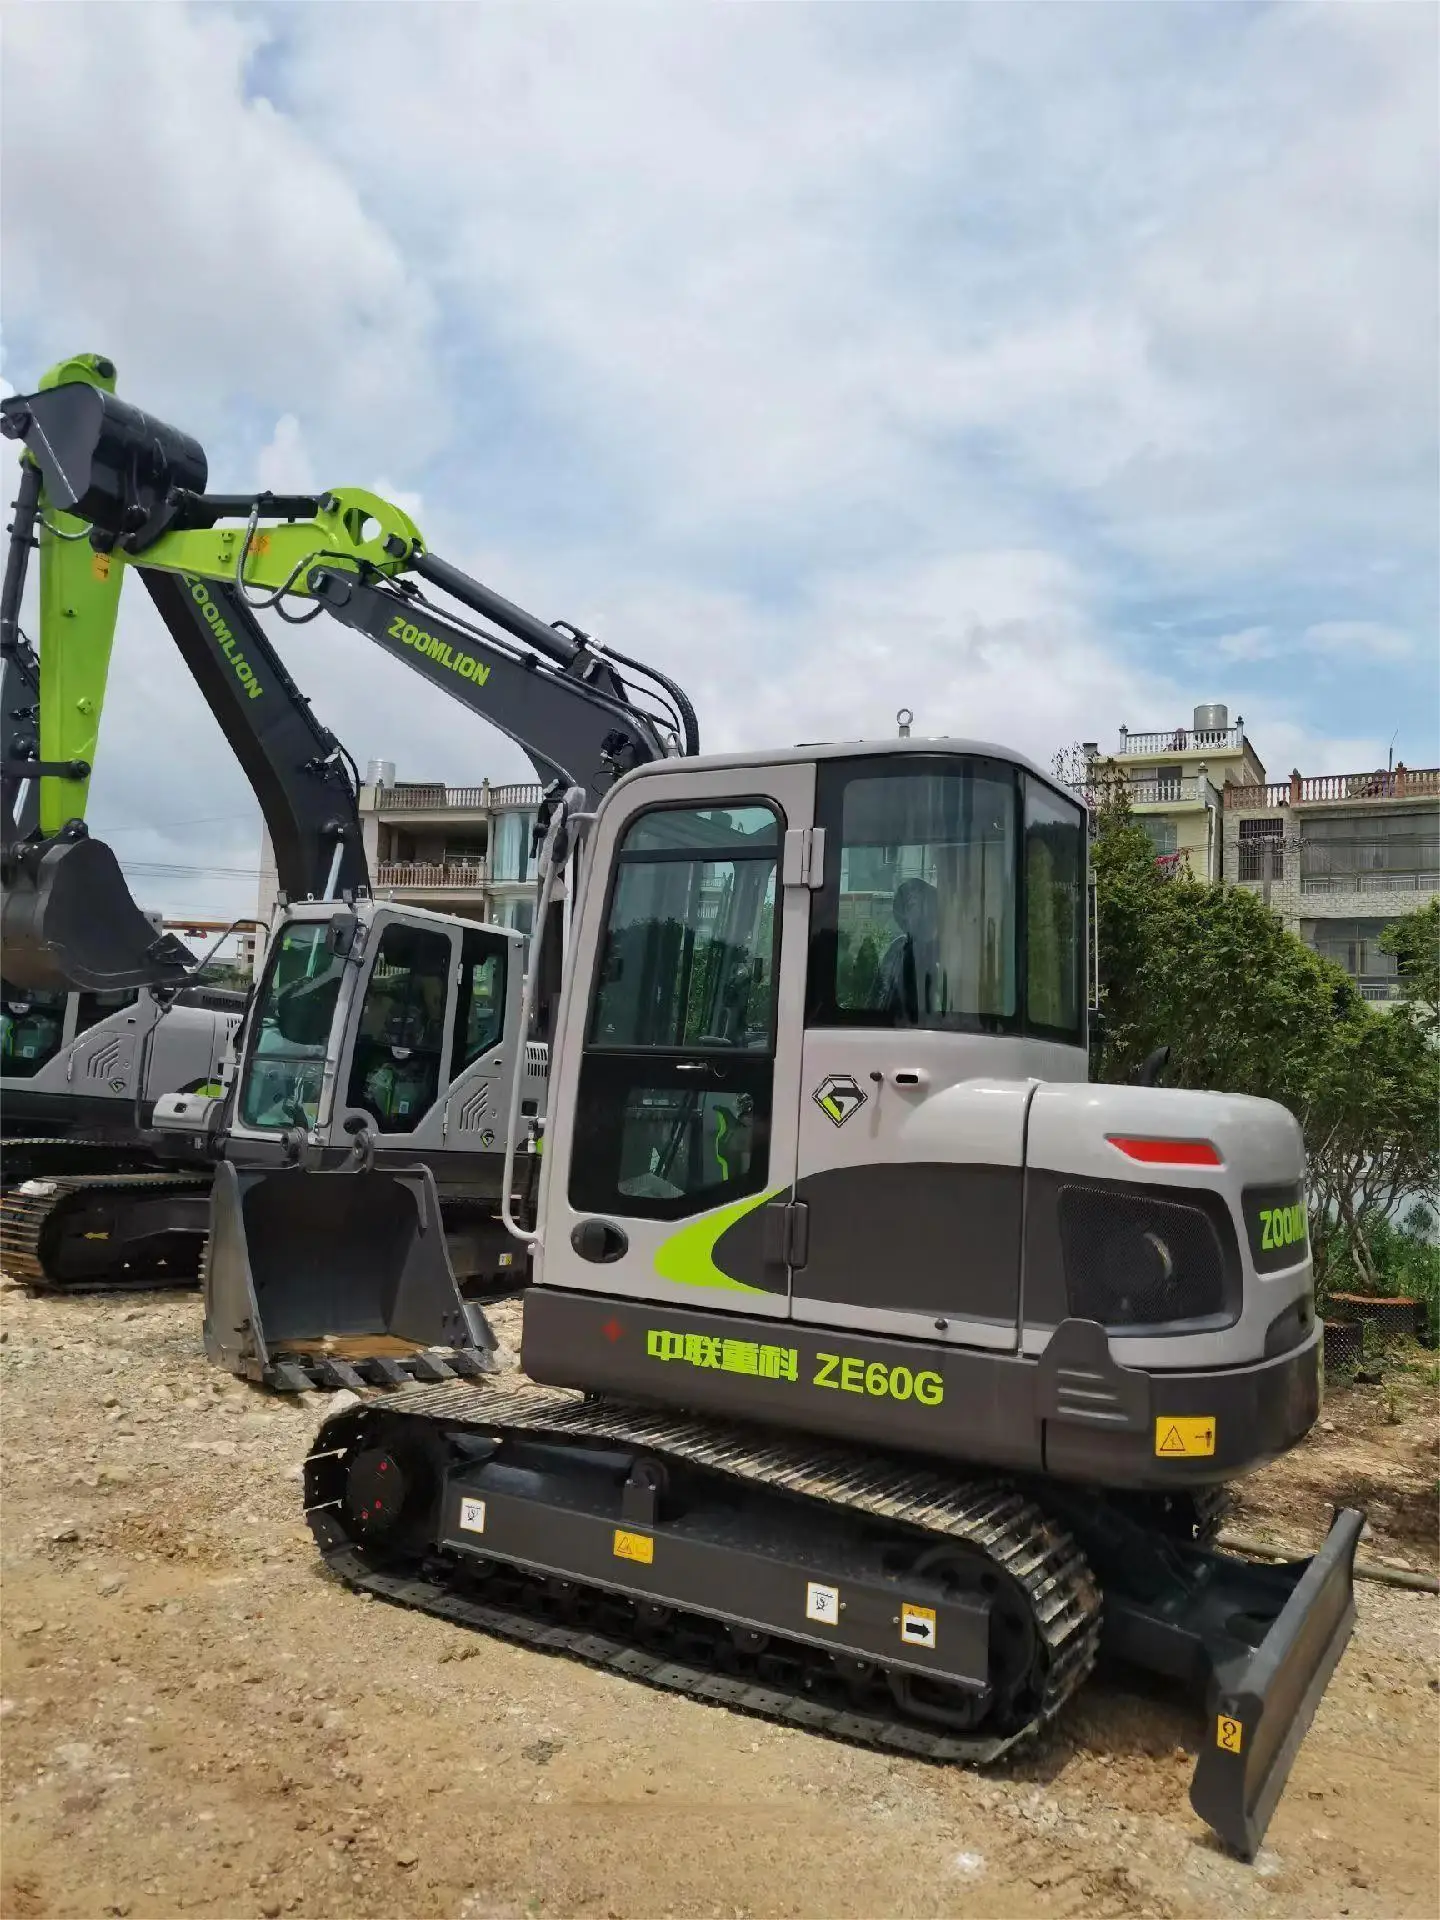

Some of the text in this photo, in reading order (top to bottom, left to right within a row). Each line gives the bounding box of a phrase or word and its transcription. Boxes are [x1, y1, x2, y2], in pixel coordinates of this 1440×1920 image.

[387, 616, 491, 687] ZOOMLION
[646, 1329, 944, 1405] 中联重科 ZE60G
